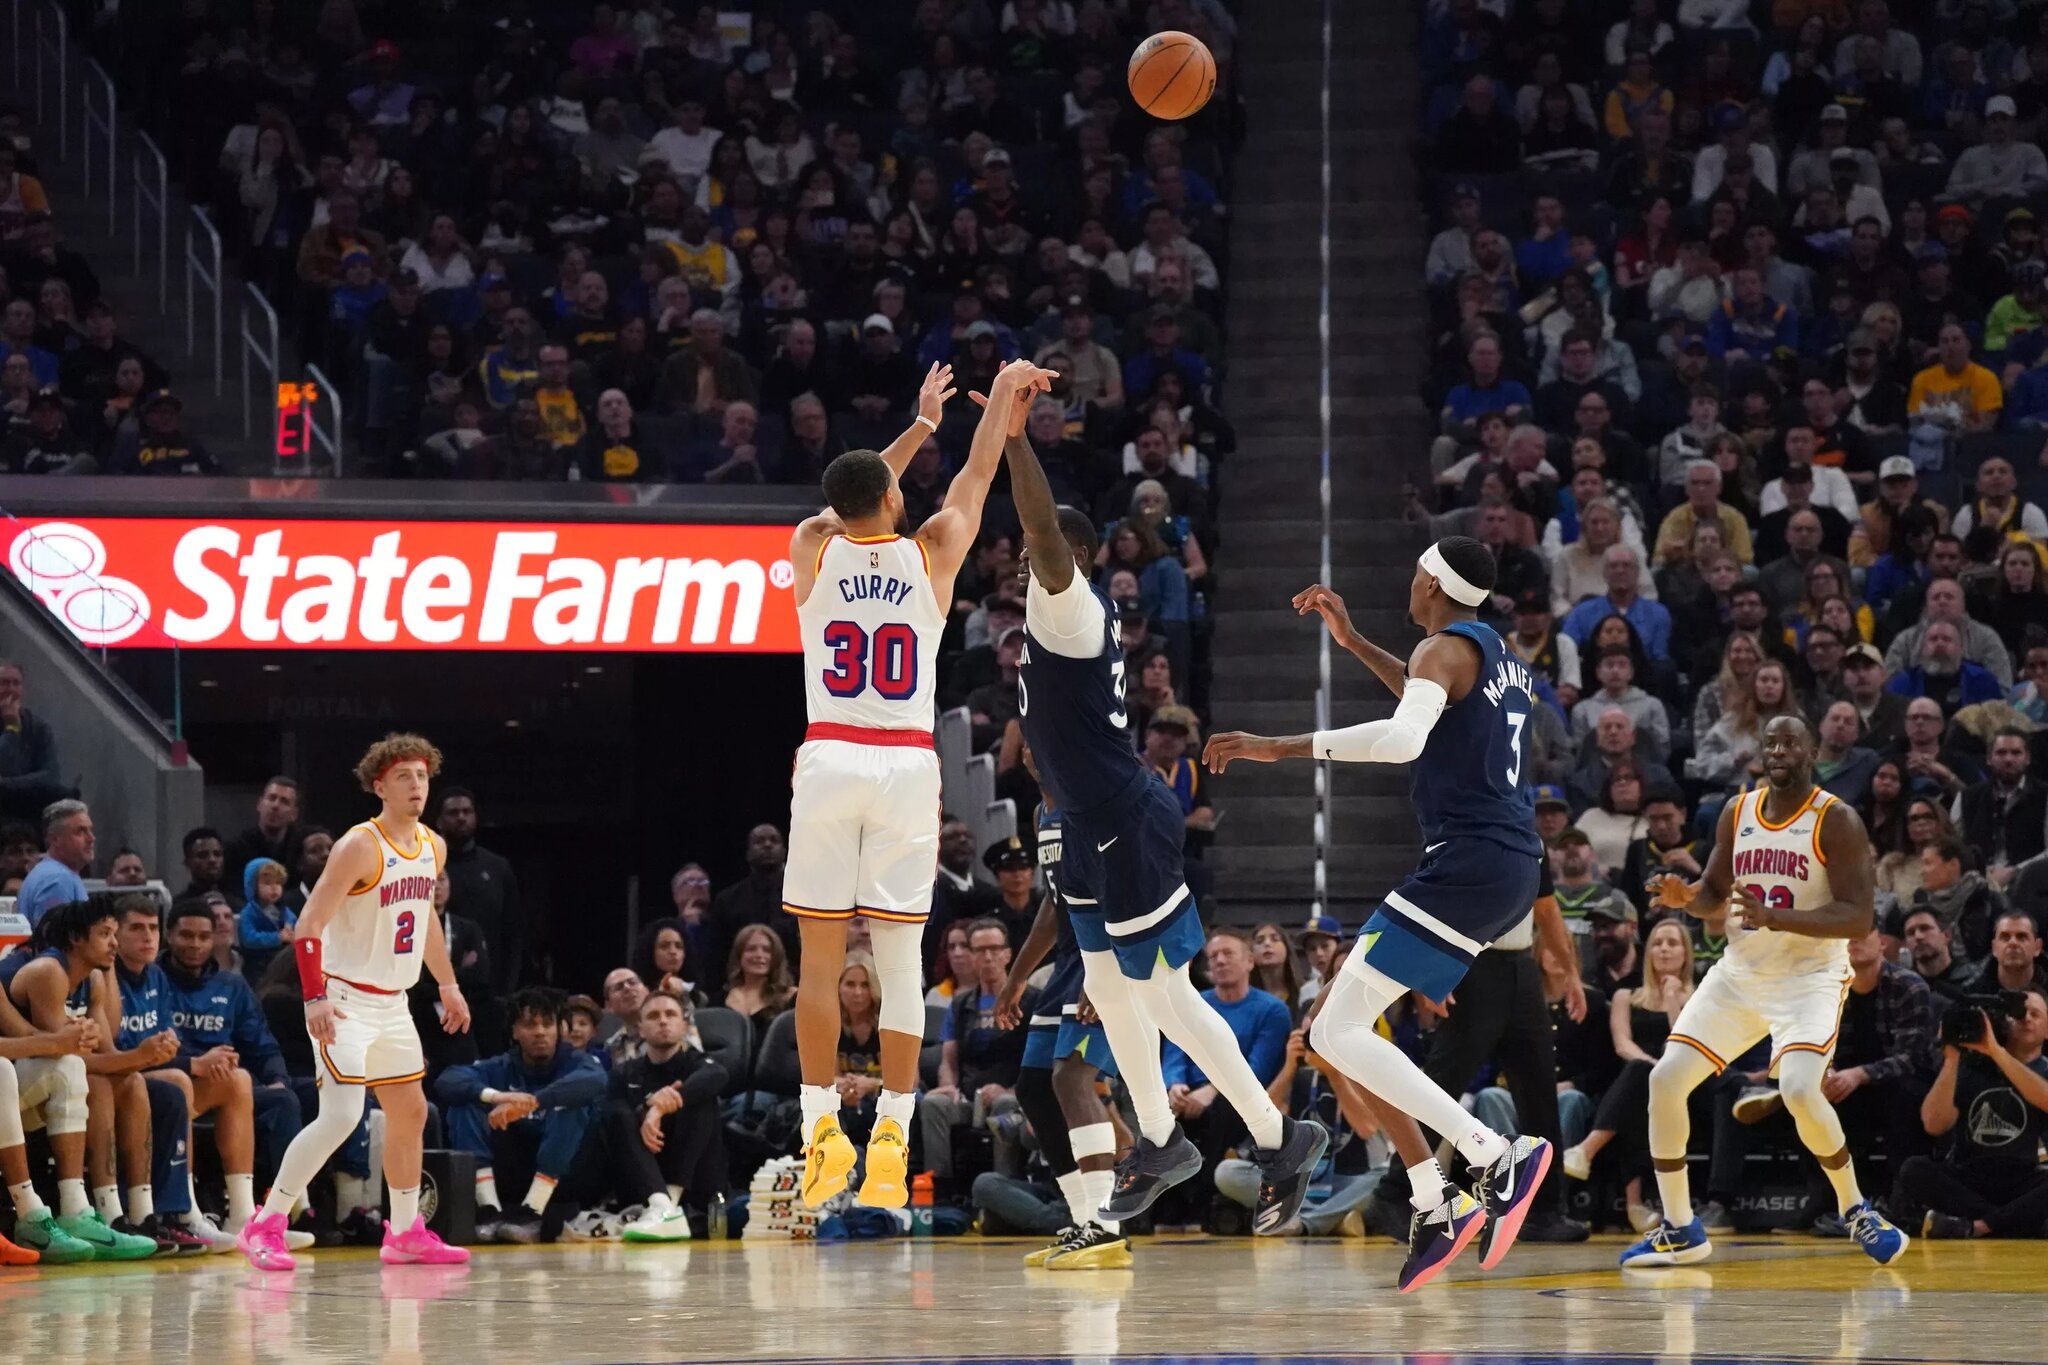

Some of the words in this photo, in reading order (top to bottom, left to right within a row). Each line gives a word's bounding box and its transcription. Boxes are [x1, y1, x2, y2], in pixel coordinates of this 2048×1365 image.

[838, 574, 914, 607] CURRY
[822, 620, 918, 701] 30
[1506, 711, 1527, 789] 3
[1734, 848, 1809, 881] WARRIORS
[394, 910, 415, 955] 2
